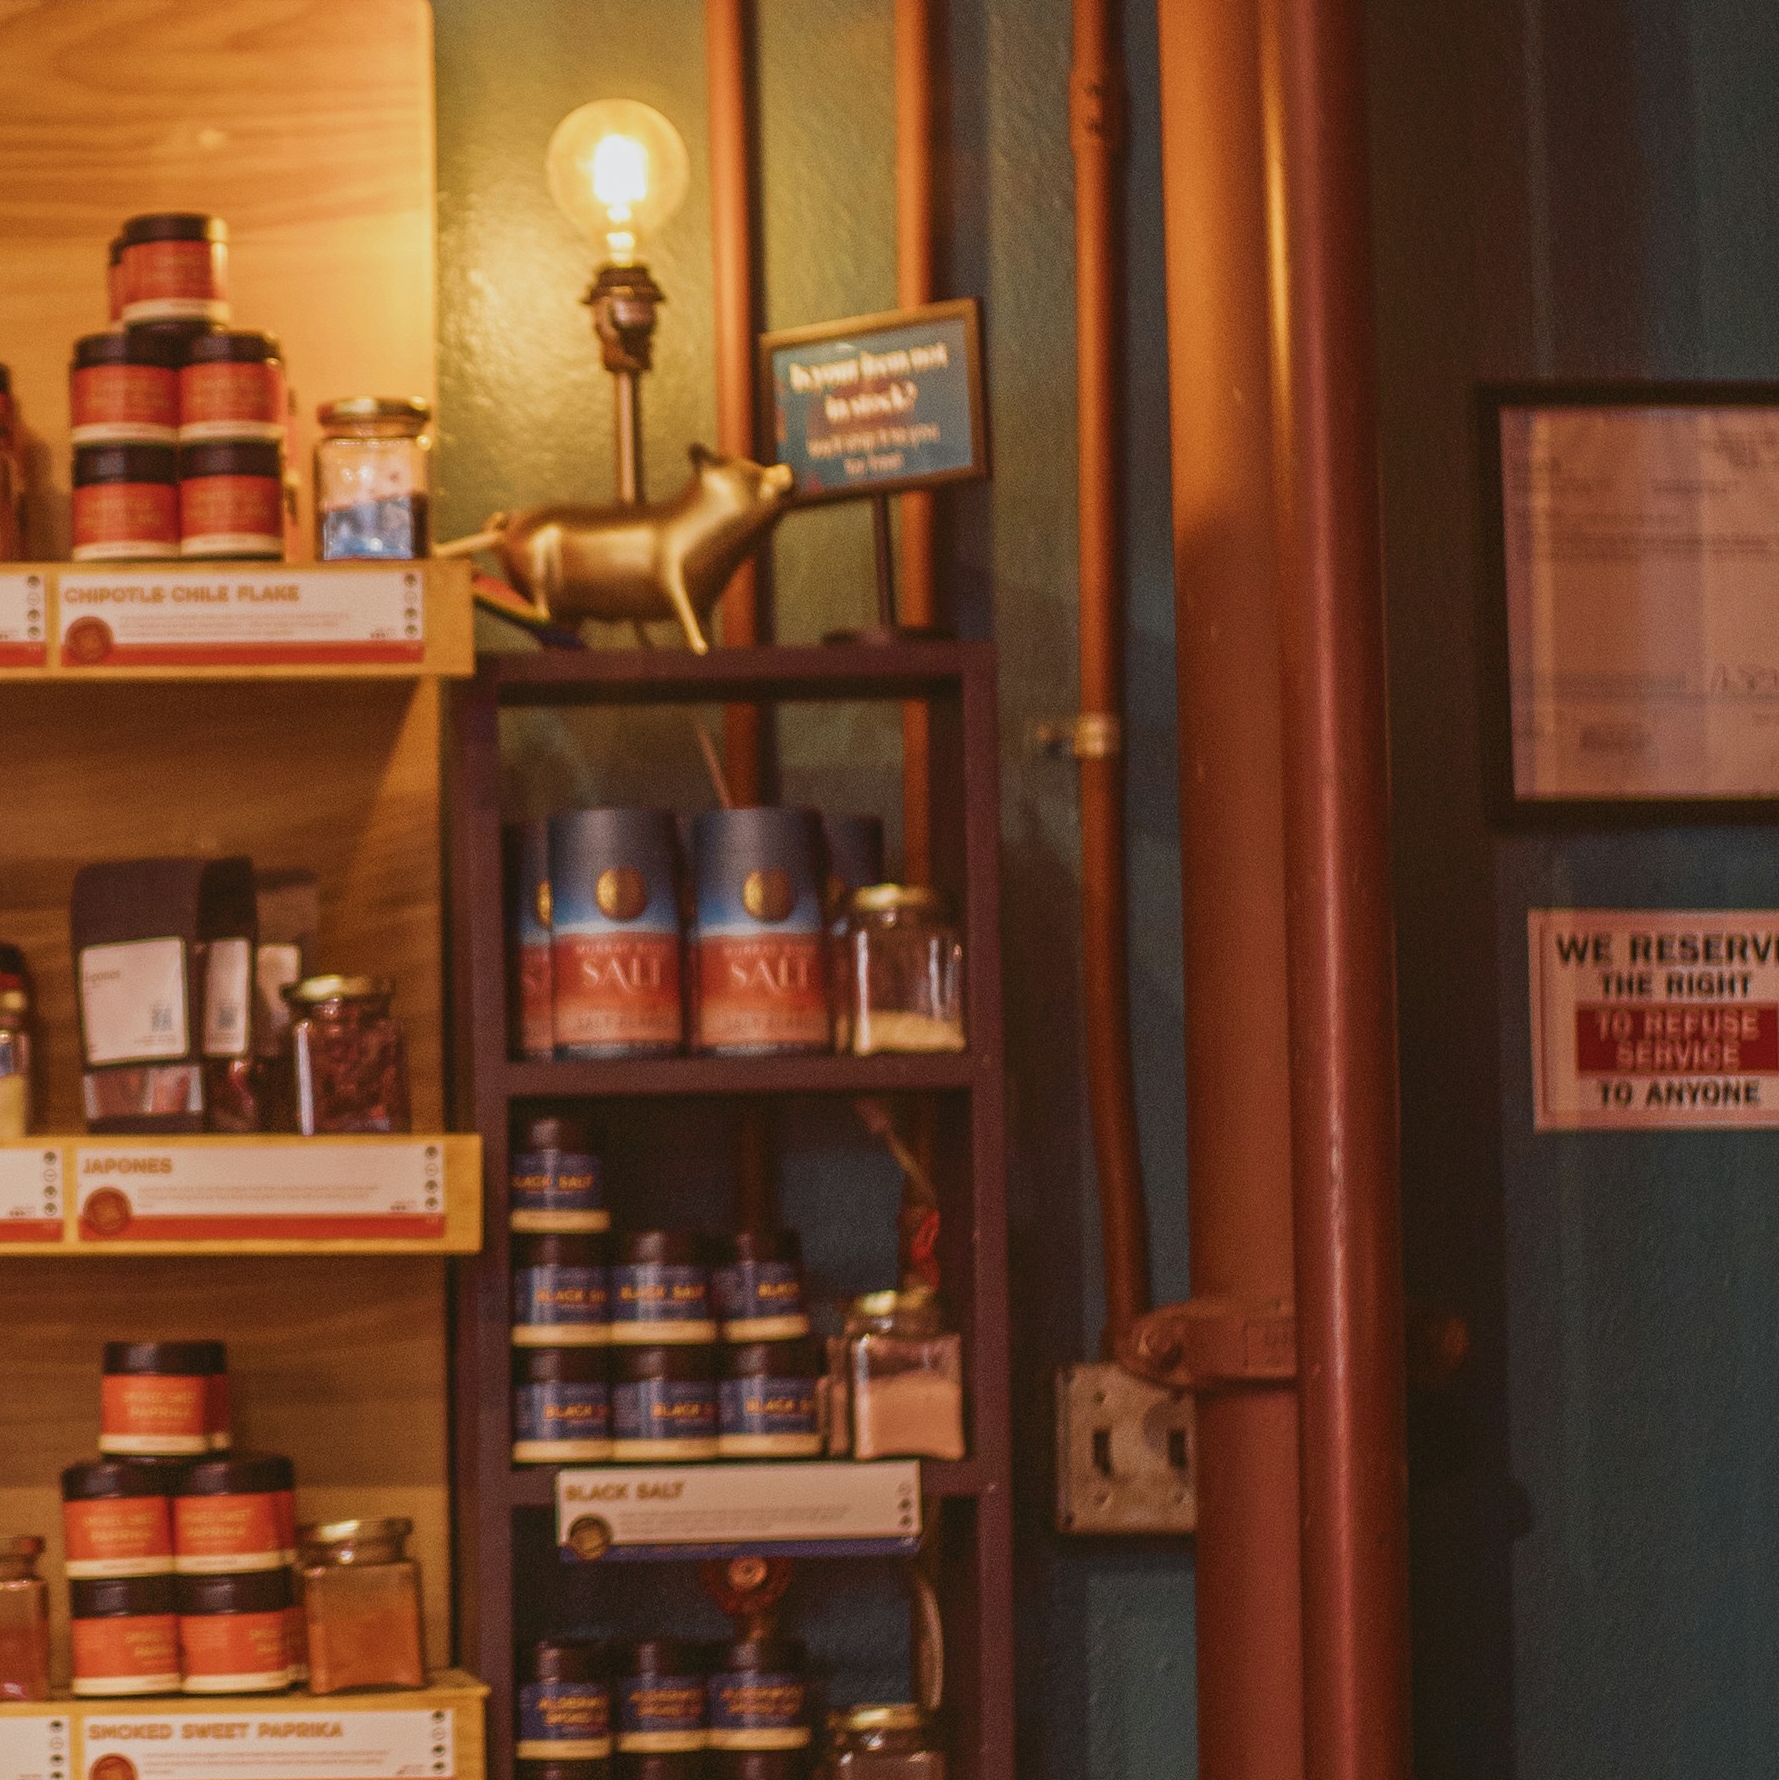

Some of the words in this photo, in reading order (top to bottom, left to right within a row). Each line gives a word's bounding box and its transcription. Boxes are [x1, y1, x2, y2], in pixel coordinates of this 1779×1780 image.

[64, 586, 166, 603] CHIPOTLE
[171, 586, 229, 603] CHILE
[236, 586, 300, 603] FLAKE
[1555, 934, 1612, 965] WE
[1629, 934, 1779, 965] RESERV
[1600, 973, 1653, 999] THE
[1666, 973, 1751, 999] RIGHT
[1596, 1013, 1634, 1041] TO
[1644, 1013, 1761, 1041] REFUSE
[1616, 1042, 1740, 1070] SERVICE
[1598, 1081, 1634, 1108] TO
[1645, 1081, 1761, 1108] ANYONE
[82, 1157, 173, 1175] JAPONES
[564, 1483, 629, 1500] BLACK
[635, 1481, 685, 1500] SALT
[88, 1722, 173, 1739] SMOKED
[181, 1722, 250, 1739] SWEET
[257, 1722, 344, 1739] PAPRIKA
